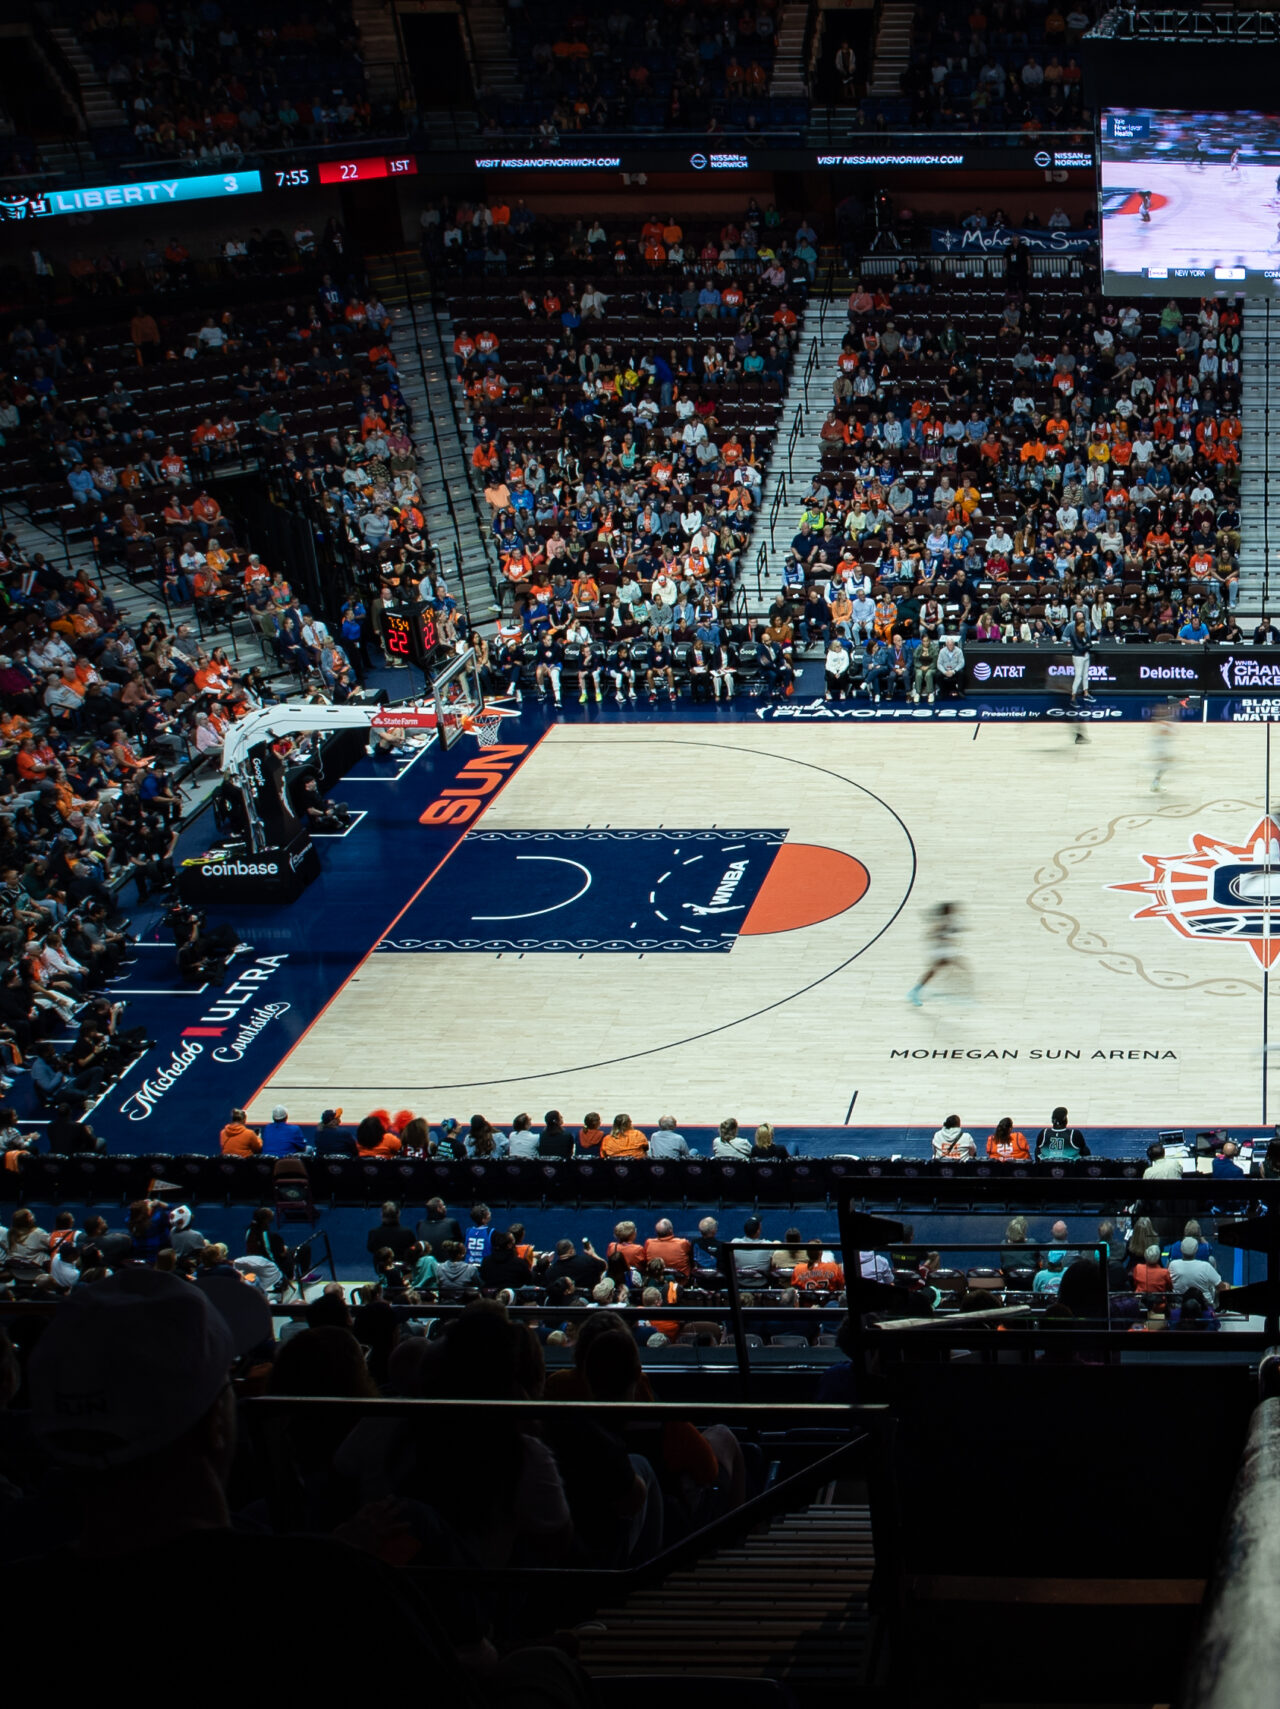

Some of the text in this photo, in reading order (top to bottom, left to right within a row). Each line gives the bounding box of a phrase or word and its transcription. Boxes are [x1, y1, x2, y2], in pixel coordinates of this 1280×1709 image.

[390, 160, 410, 172] 1ST
[475, 157, 620, 168] VISIT NISSANOFNORWICH.COM
[817, 155, 963, 165] VISIT NISSANOFNORWICH.COM
[275, 169, 309, 187] 7:55
[340, 165, 359, 179] 22
[56, 182, 179, 211] LIBERTY
[223, 177, 239, 192] 3
[962, 229, 1090, 251] Mohean Sun
[388, 616, 410, 631] 7:54
[422, 611, 435, 624] 7:54
[388, 630, 409, 653] 22
[423, 622, 436, 650] 22
[993, 665, 1025, 677] AT&T
[1048, 665, 1108, 676] CARax
[1140, 665, 1199, 679] Deloitte.
[981, 707, 1122, 719] Presented by Google
[252, 757, 264, 787] Google
[419, 744, 529, 825] SUN
[201, 860, 278, 876] coinbase
[709, 860, 749, 905] WNBA
[120, 954, 289, 1121] Michelob ULTRA
[212, 1002, 291, 1063] Courtside
[890, 1049, 1177, 1060] MOHEGAN SUN ARENA
[468, 1238, 484, 1250] 25
